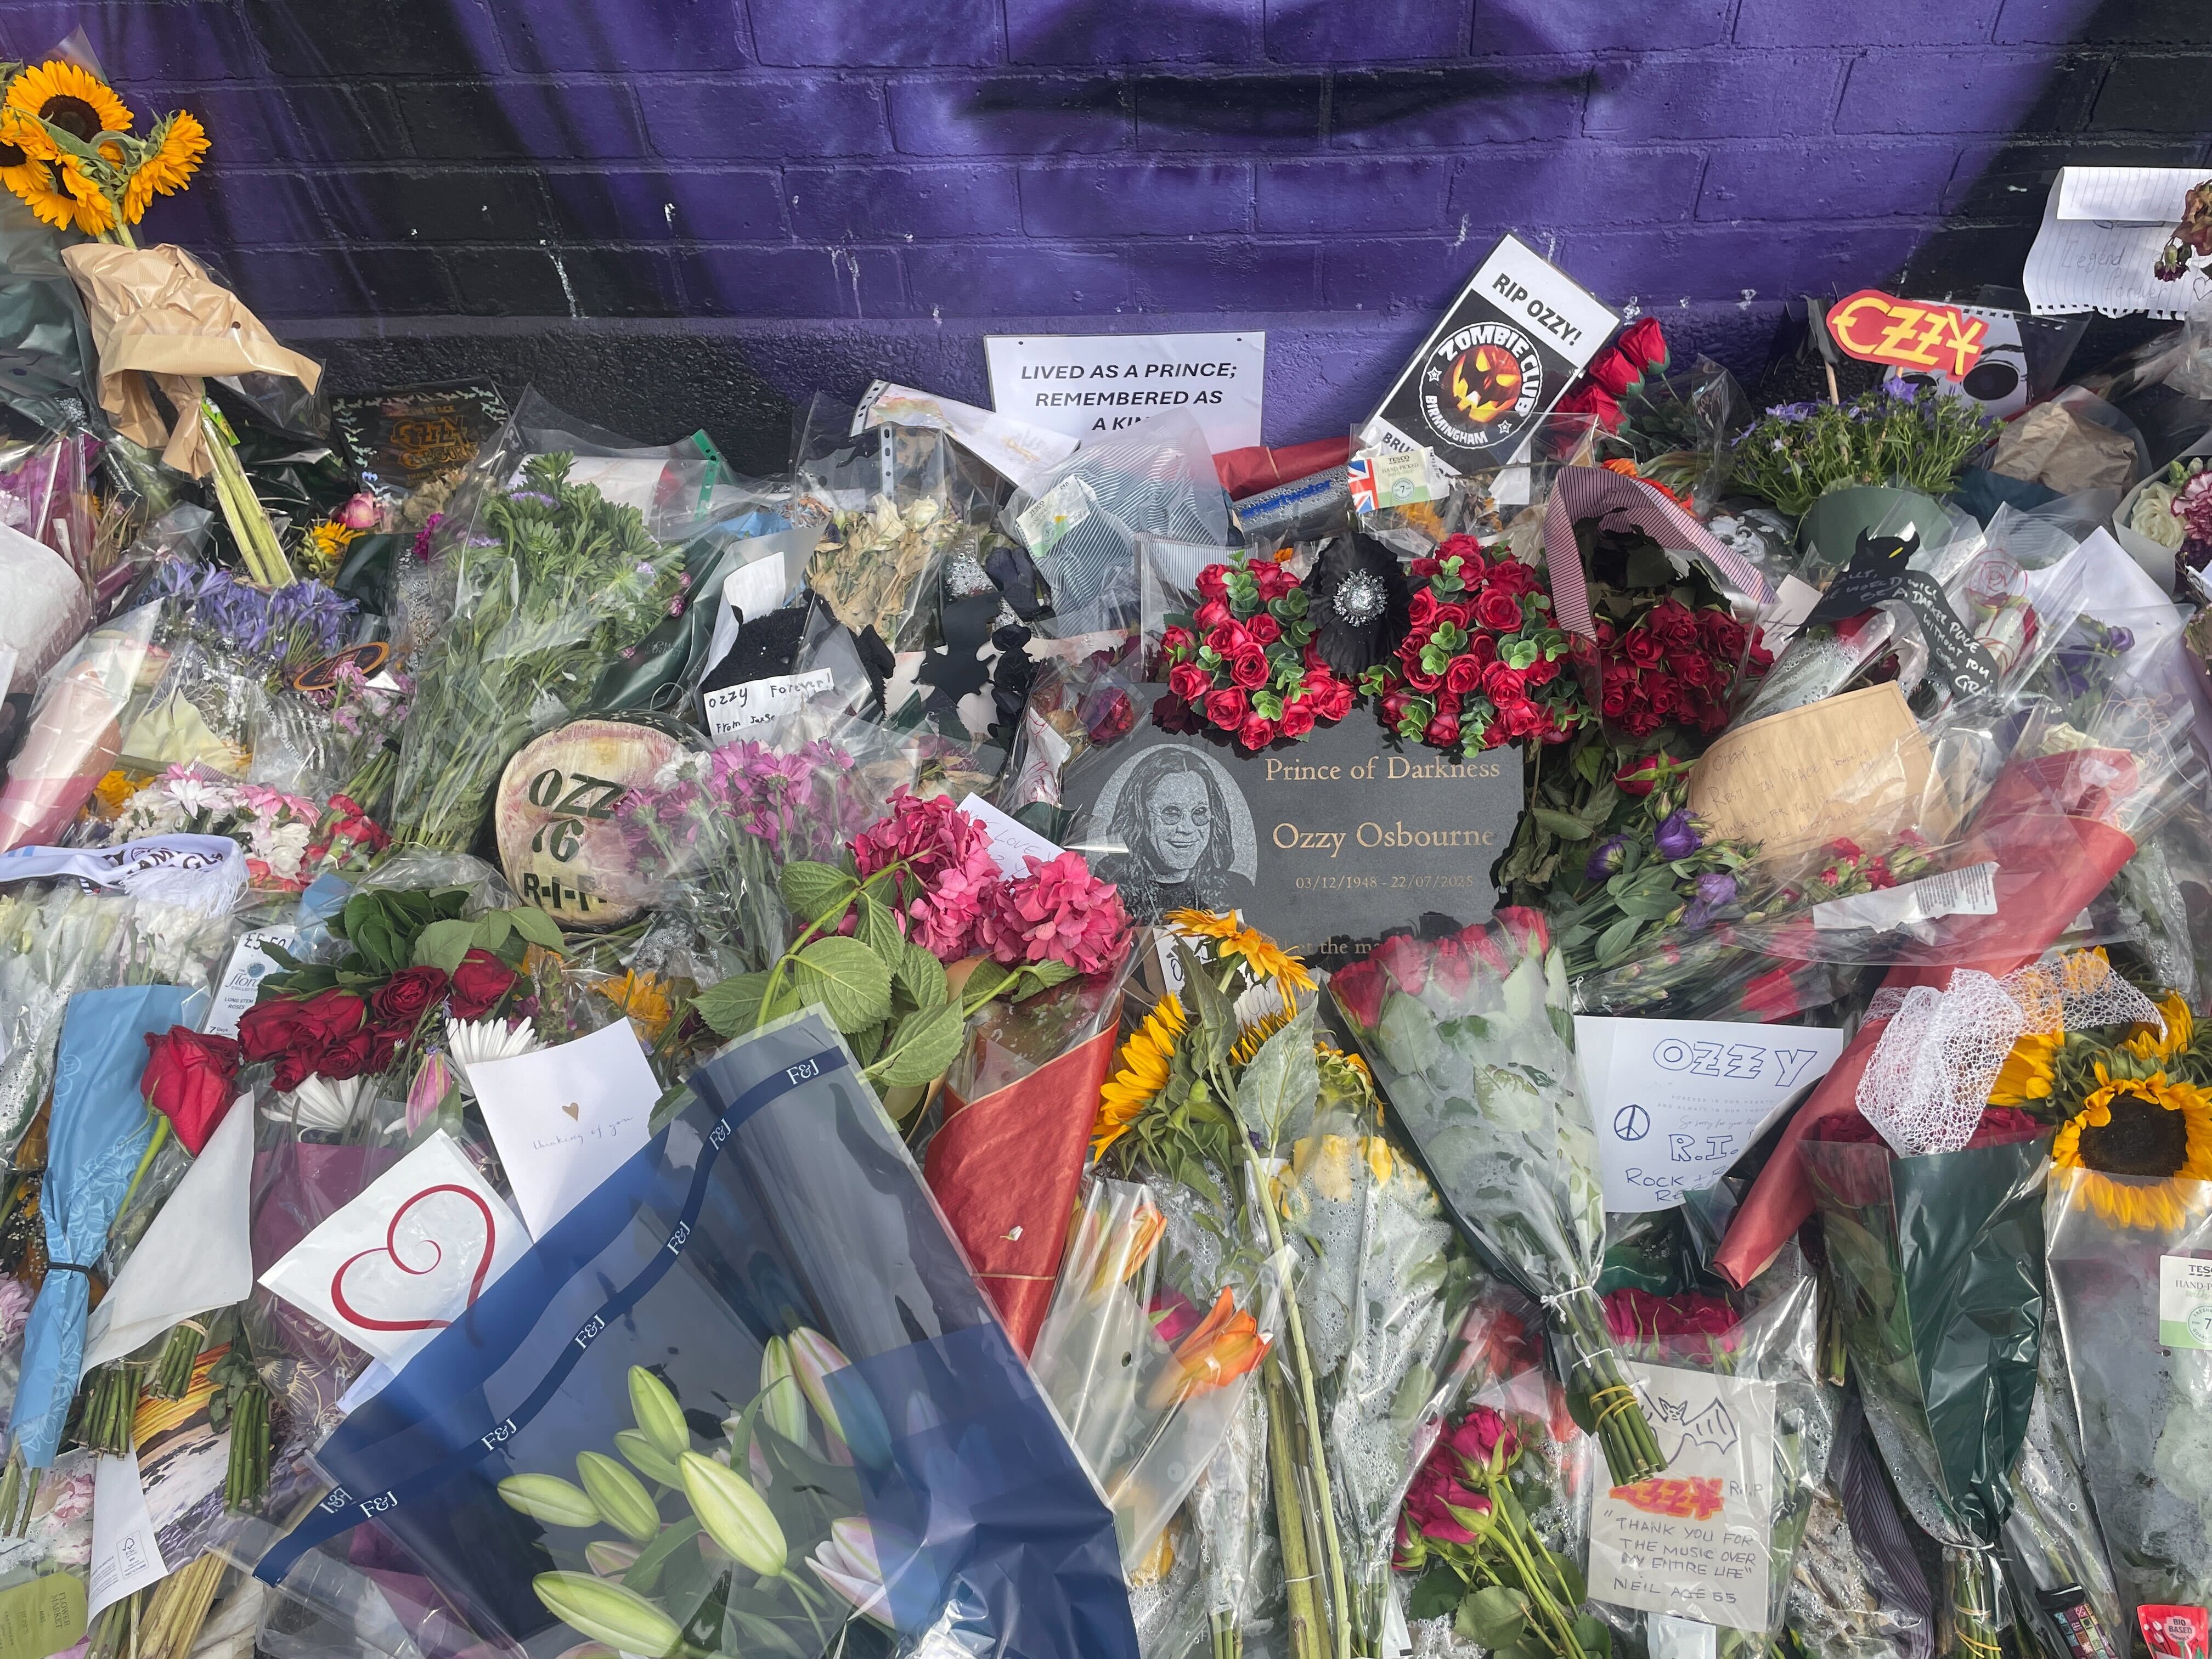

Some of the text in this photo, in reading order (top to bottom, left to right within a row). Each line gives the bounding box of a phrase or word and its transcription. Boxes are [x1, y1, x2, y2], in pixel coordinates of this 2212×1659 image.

[1492, 273, 1582, 347] RIP OZZY!
[1021, 362, 1238, 380] LIVED AS A PRINCE;
[1438, 325, 1541, 417] ZOMBIE CLUB
[1035, 390, 1224, 407] REMEMBERED AS
[1091, 417, 1107, 431] A
[1425, 395, 1489, 444] BIRMINGHAM
[1382, 432, 1415, 453] BRU
[1388, 455, 1410, 464] TESCO
[1029, 500, 1045, 517] TESCO
[1892, 586, 1908, 598] A
[1923, 613, 1963, 657] WITHOUT
[1265, 755, 1501, 782] Prince of Darkness
[529, 768, 628, 820] OZZ
[994, 829, 1041, 855] LOVE
[1272, 820, 1494, 858] Ozzy Osbourne
[1296, 876, 1378, 890] 03/12/1948
[1390, 875, 1473, 889] 22/07/2025
[1321, 936, 1348, 955] the
[786, 1058, 820, 1085] F&J
[1653, 1038, 1818, 1087] OZZY
[1672, 1094, 1707, 1103] FOREVER
[590, 1125, 602, 1138] of
[609, 1116, 634, 1137] you
[1679, 1115, 1692, 1130] So
[1694, 1120, 1713, 1130] sorry
[1715, 1119, 1725, 1129] for
[1729, 1120, 1742, 1130] your
[709, 1118, 731, 1150] F&J
[1625, 1167, 1685, 1187] ROCK
[667, 1220, 691, 1256] F&J
[2188, 1265, 2212, 1274] TES
[574, 1314, 605, 1350] F&J
[2204, 1318, 2212, 1330] 7
[481, 1418, 517, 1452] F&J
[359, 1491, 398, 1519] F&J
[1684, 1526, 1714, 1542] YOU
[1723, 1532, 1753, 1546] FOR
[1619, 1538, 1756, 1566] THE MUSIC OVER
[1651, 1557, 1707, 1576] ENTIRE
[1613, 1578, 1661, 1594] NEIL
[1671, 1586, 1706, 1599] AGE
[52, 1594, 63, 1628] MARKET
[58, 1592, 71, 1627] FLOWER
[2168, 1624, 2193, 1635] BASED
[2172, 1618, 2187, 1627] BIO
